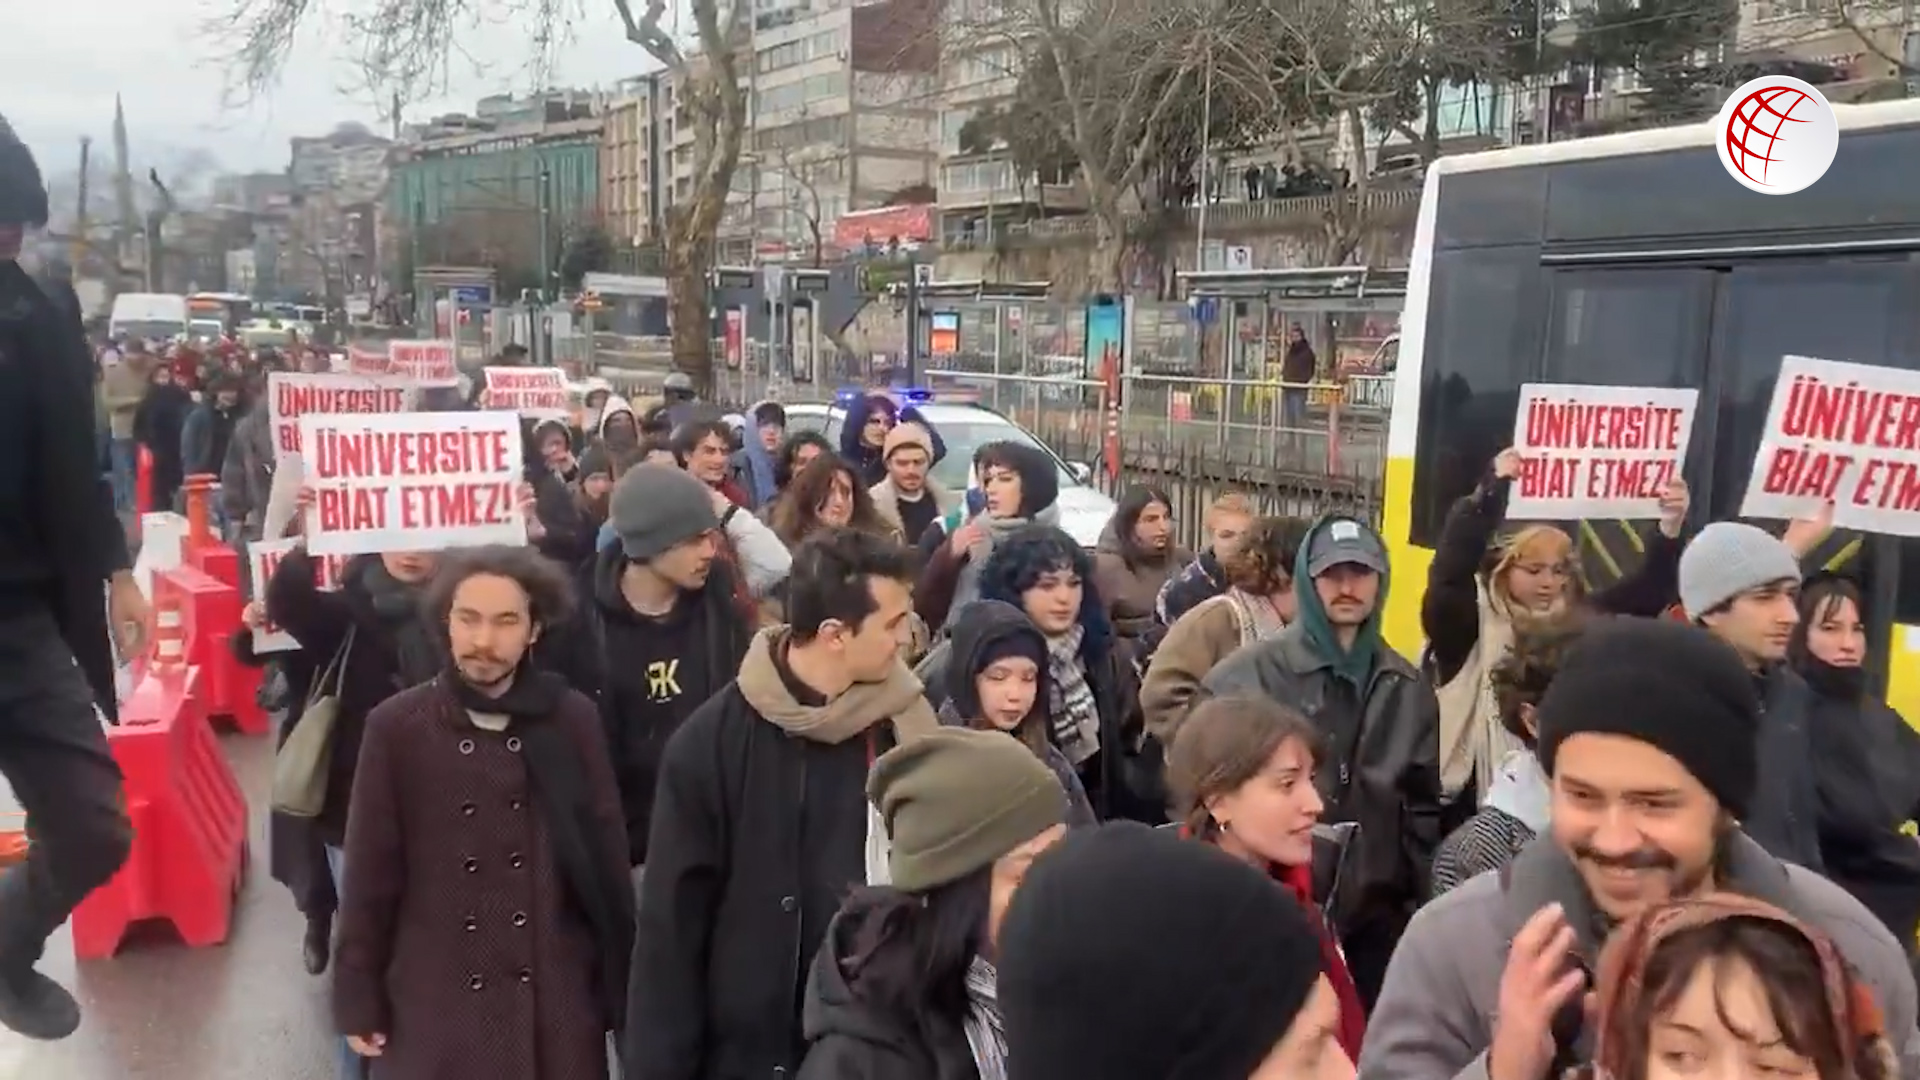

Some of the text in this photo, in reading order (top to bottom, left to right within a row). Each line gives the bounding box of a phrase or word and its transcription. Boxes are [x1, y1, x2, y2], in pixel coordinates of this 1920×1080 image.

[1527, 397, 1683, 450] ÜNİVERSİTE
[316, 427, 510, 478] ÜNİVERSİTE
[1521, 453, 1581, 498] BİAT
[1763, 443, 1854, 505] BİAT
[319, 482, 512, 532] BİAT ETMEZ!
